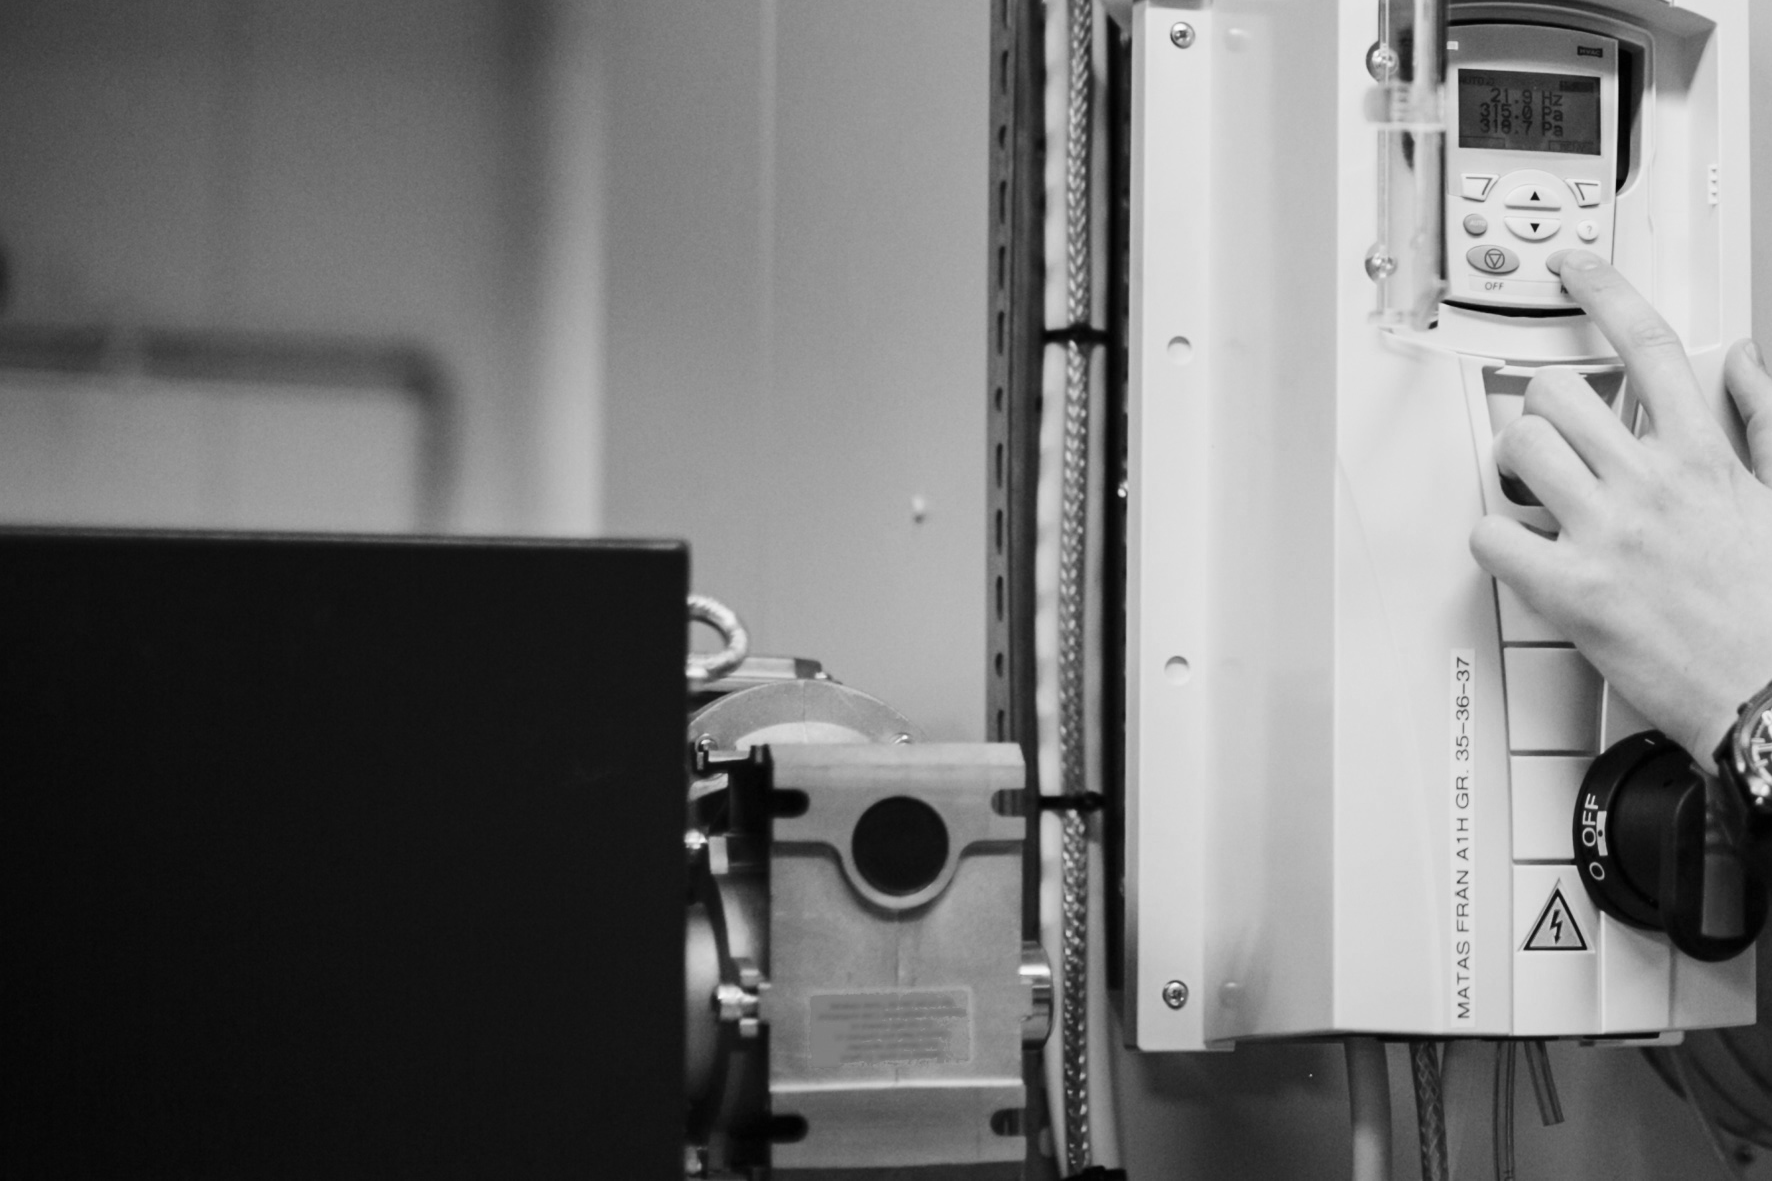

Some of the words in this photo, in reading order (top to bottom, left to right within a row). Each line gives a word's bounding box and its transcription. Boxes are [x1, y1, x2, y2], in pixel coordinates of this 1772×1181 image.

[1490, 87, 1533, 105] 21.9
[1541, 90, 1563, 106] Hz
[1480, 102, 1533, 120] 315.0
[1541, 105, 1563, 122] Pa
[1541, 121, 1563, 137] Pa
[1484, 282, 1504, 291] OFF
[1456, 769, 1469, 809] GR.
[1582, 793, 1599, 847] OFF
[1456, 941, 1470, 1019] MATAS
